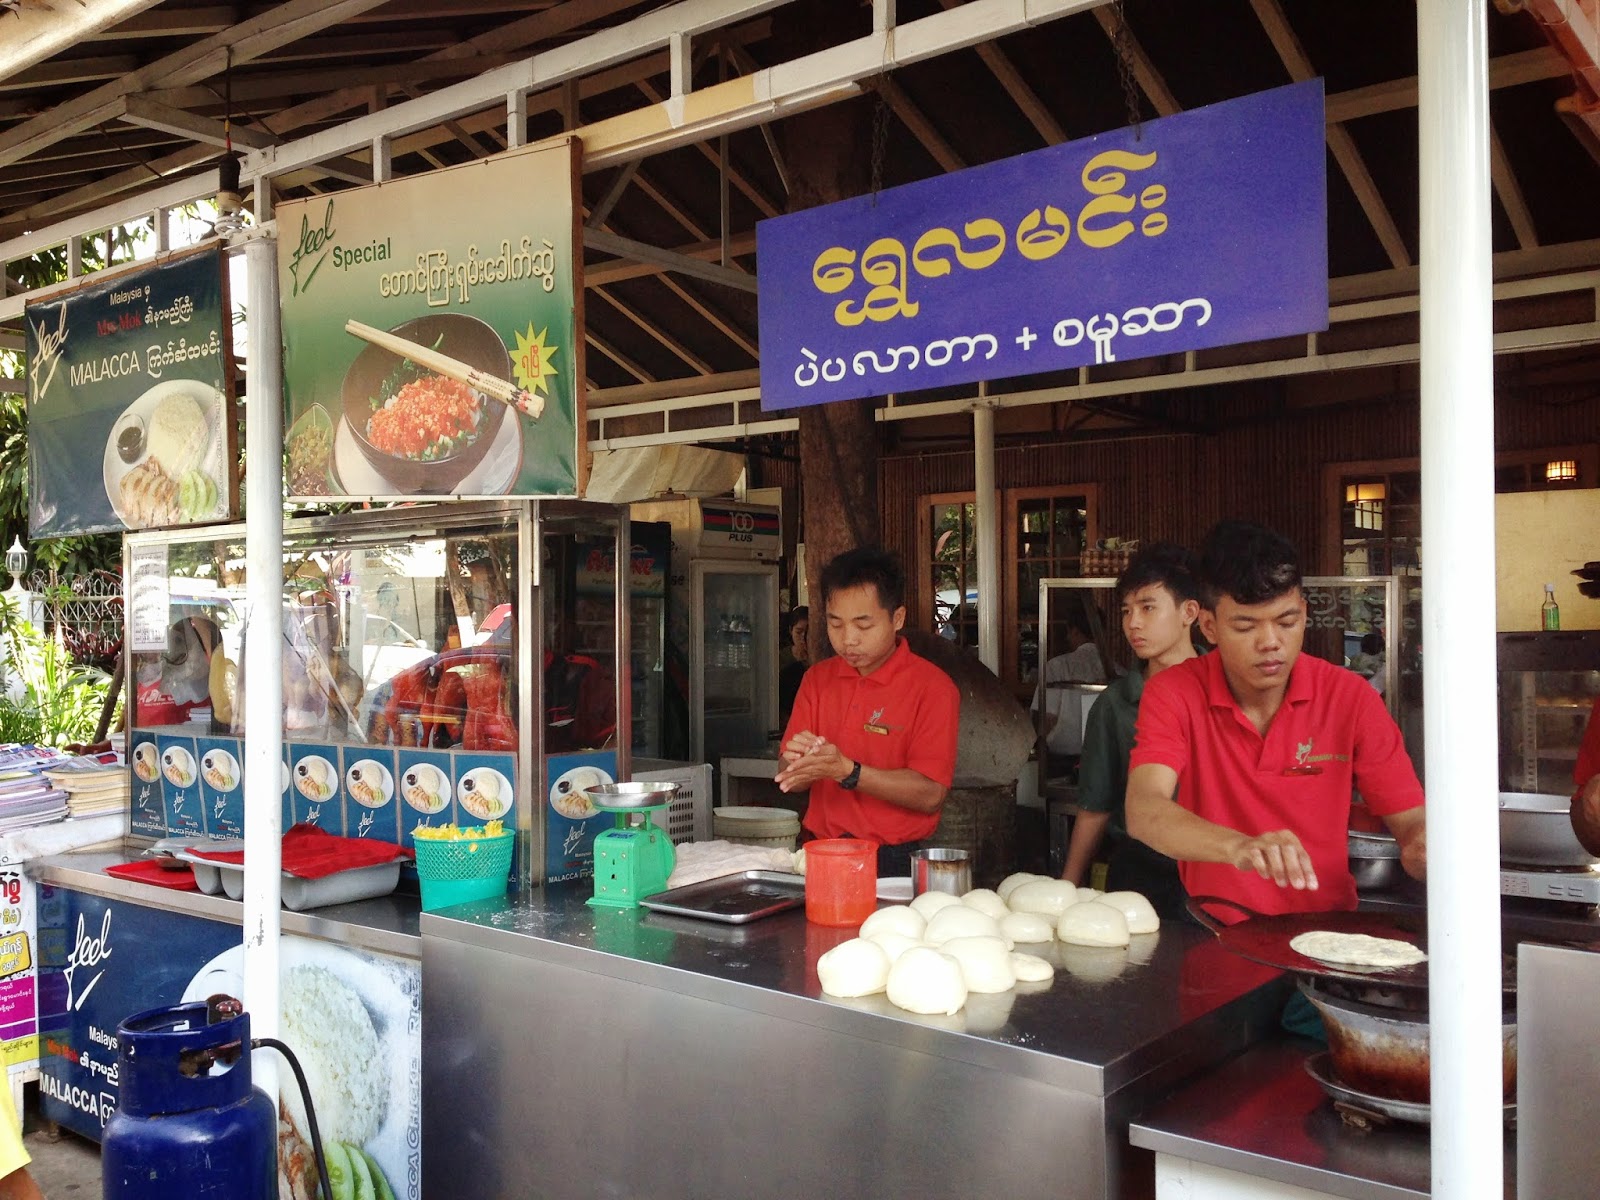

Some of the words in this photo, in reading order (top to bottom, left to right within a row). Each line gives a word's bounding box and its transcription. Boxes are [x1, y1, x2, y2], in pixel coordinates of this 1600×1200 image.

[288, 198, 336, 298] feel
[333, 237, 391, 271] Special
[110, 286, 142, 306] Malaysia
[30, 300, 69, 404] feel
[71, 350, 140, 386] MALACCA
[728, 533, 753, 542] PLUS
[729, 511, 755, 532] 100
[563, 820, 586, 855] feel
[548, 872, 579, 883] MALACCA
[63, 908, 112, 1011] feel
[89, 1026, 118, 1050] Malays
[40, 1072, 98, 1116] MALACCA
